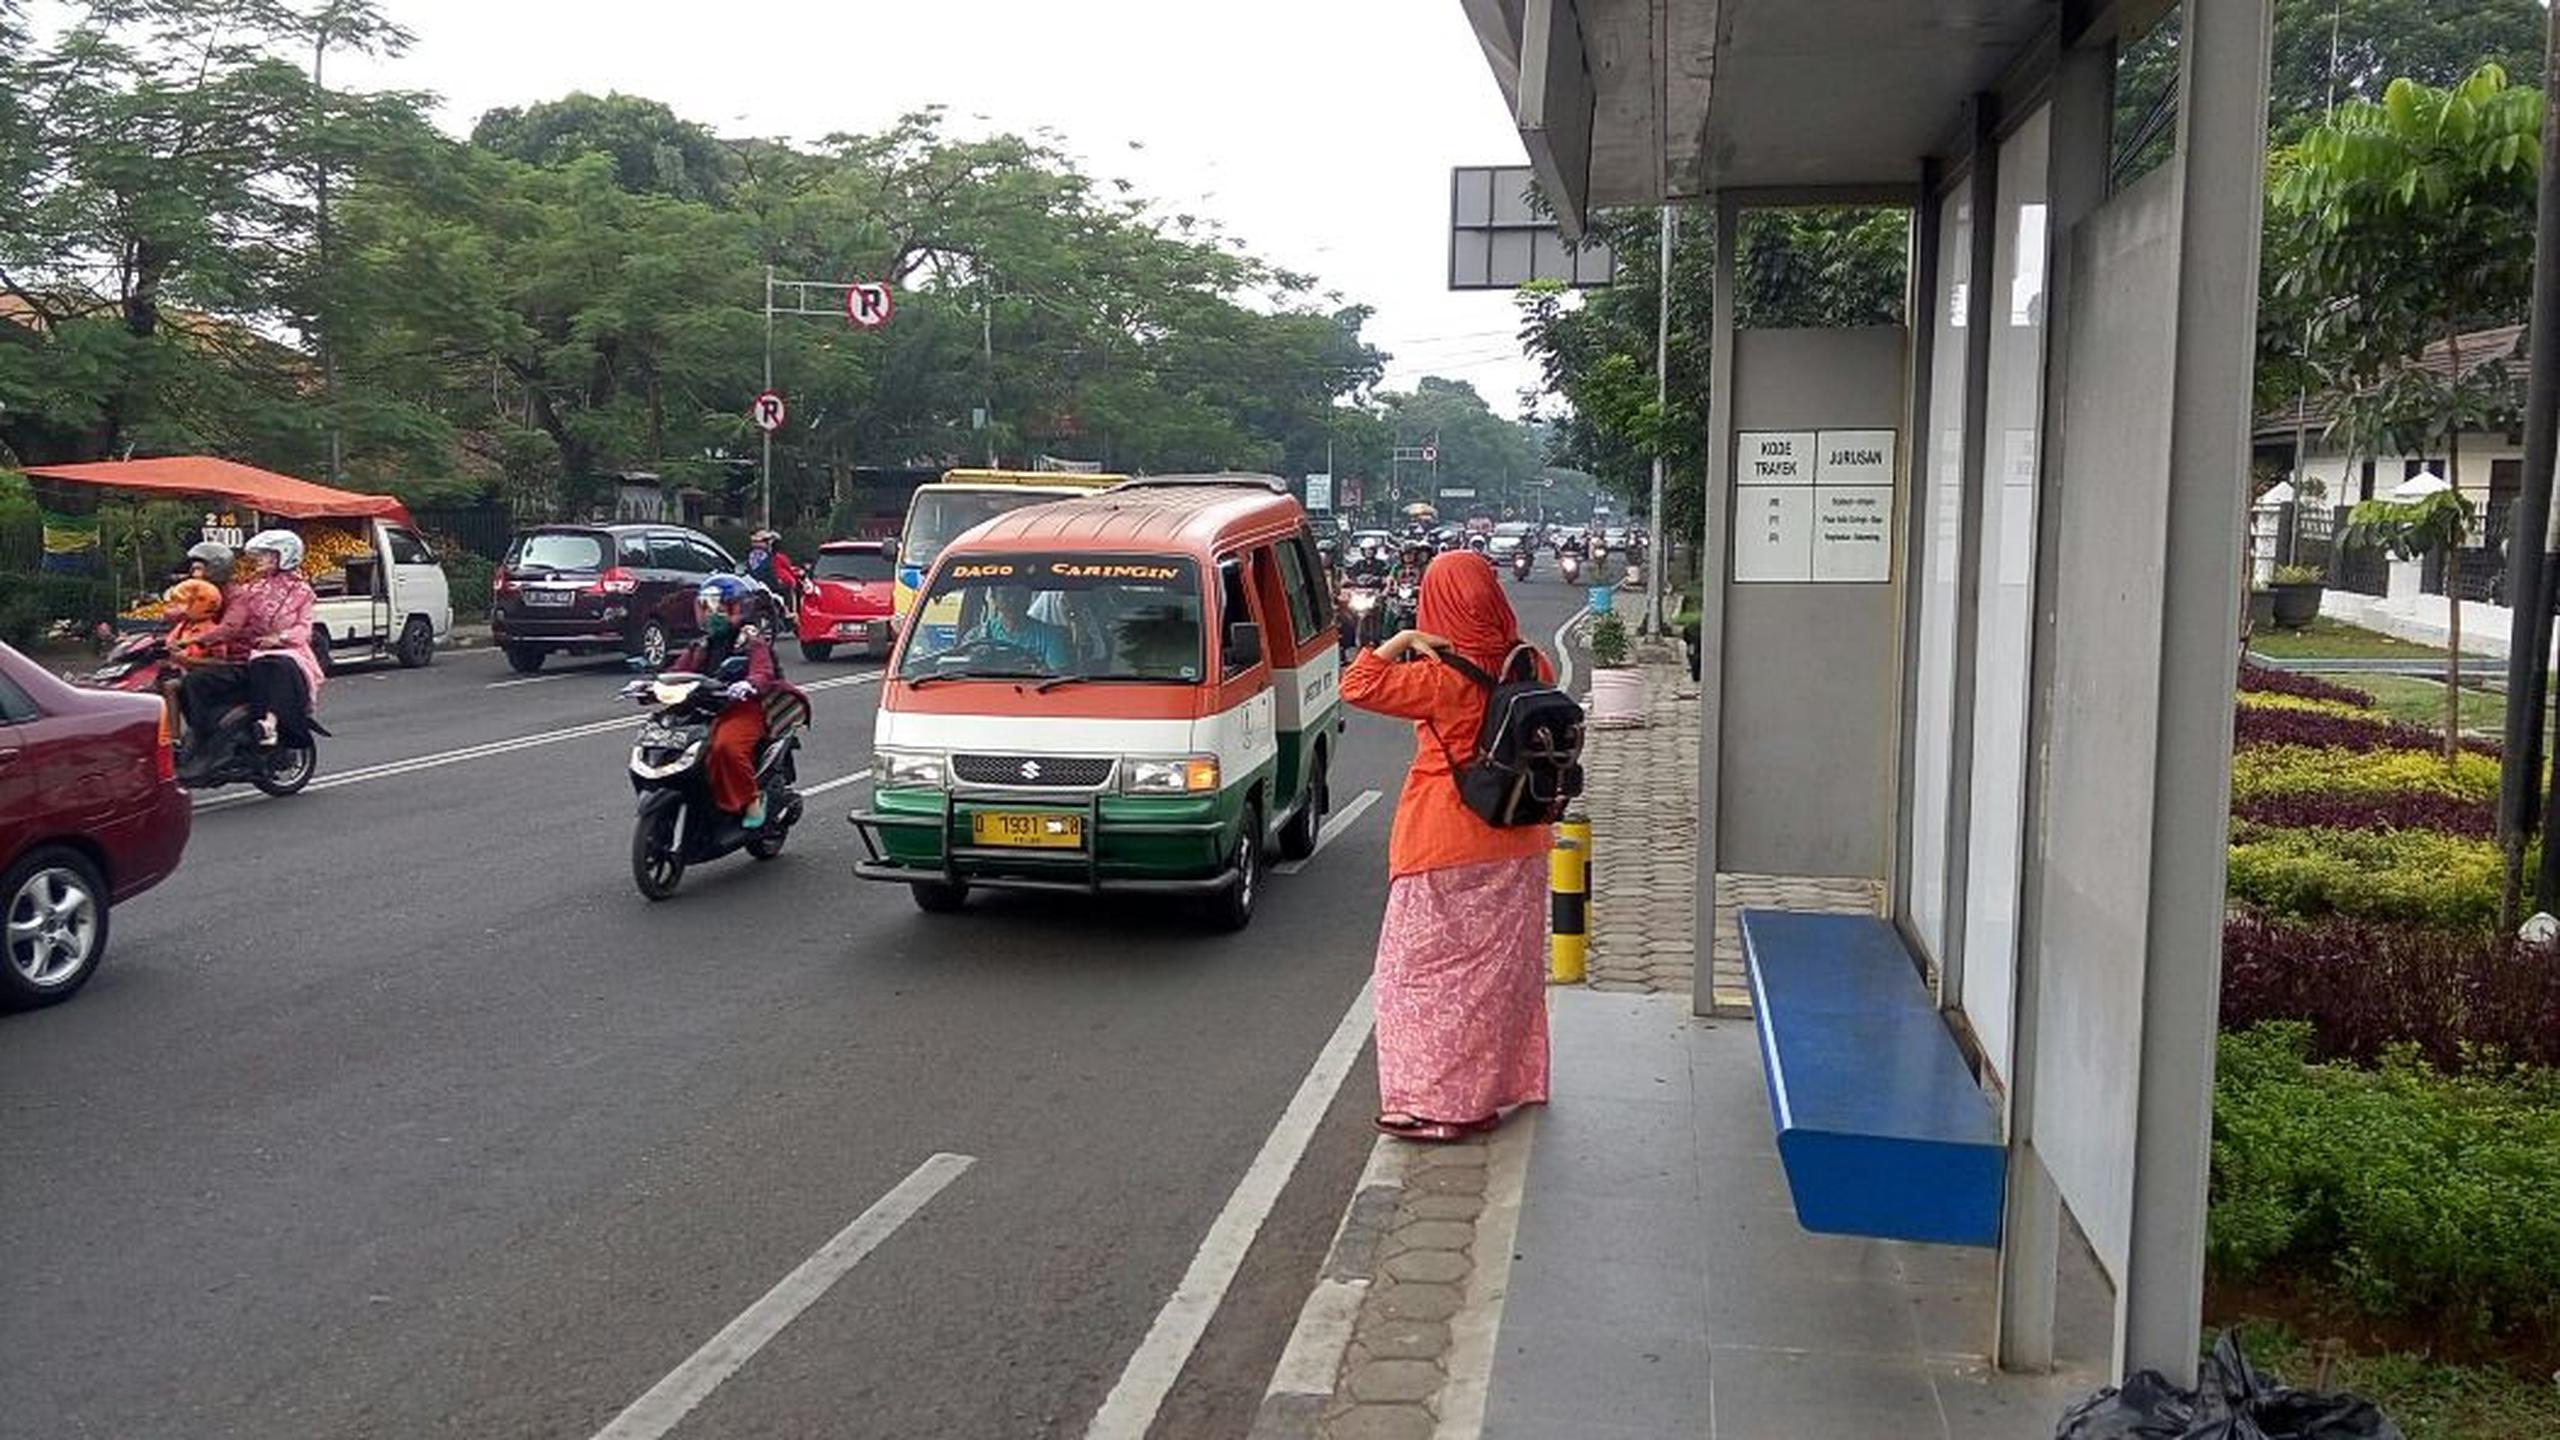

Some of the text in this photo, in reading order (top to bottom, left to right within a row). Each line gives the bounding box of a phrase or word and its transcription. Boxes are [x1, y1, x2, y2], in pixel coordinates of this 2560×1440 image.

[1760, 441, 1793, 457] KODE
[1828, 450, 1883, 466] JURUSAN
[1754, 461, 1798, 477] TRAYEK
[951, 562, 1179, 580] DAGO CARINGIN
[998, 815, 1039, 836] 1931
